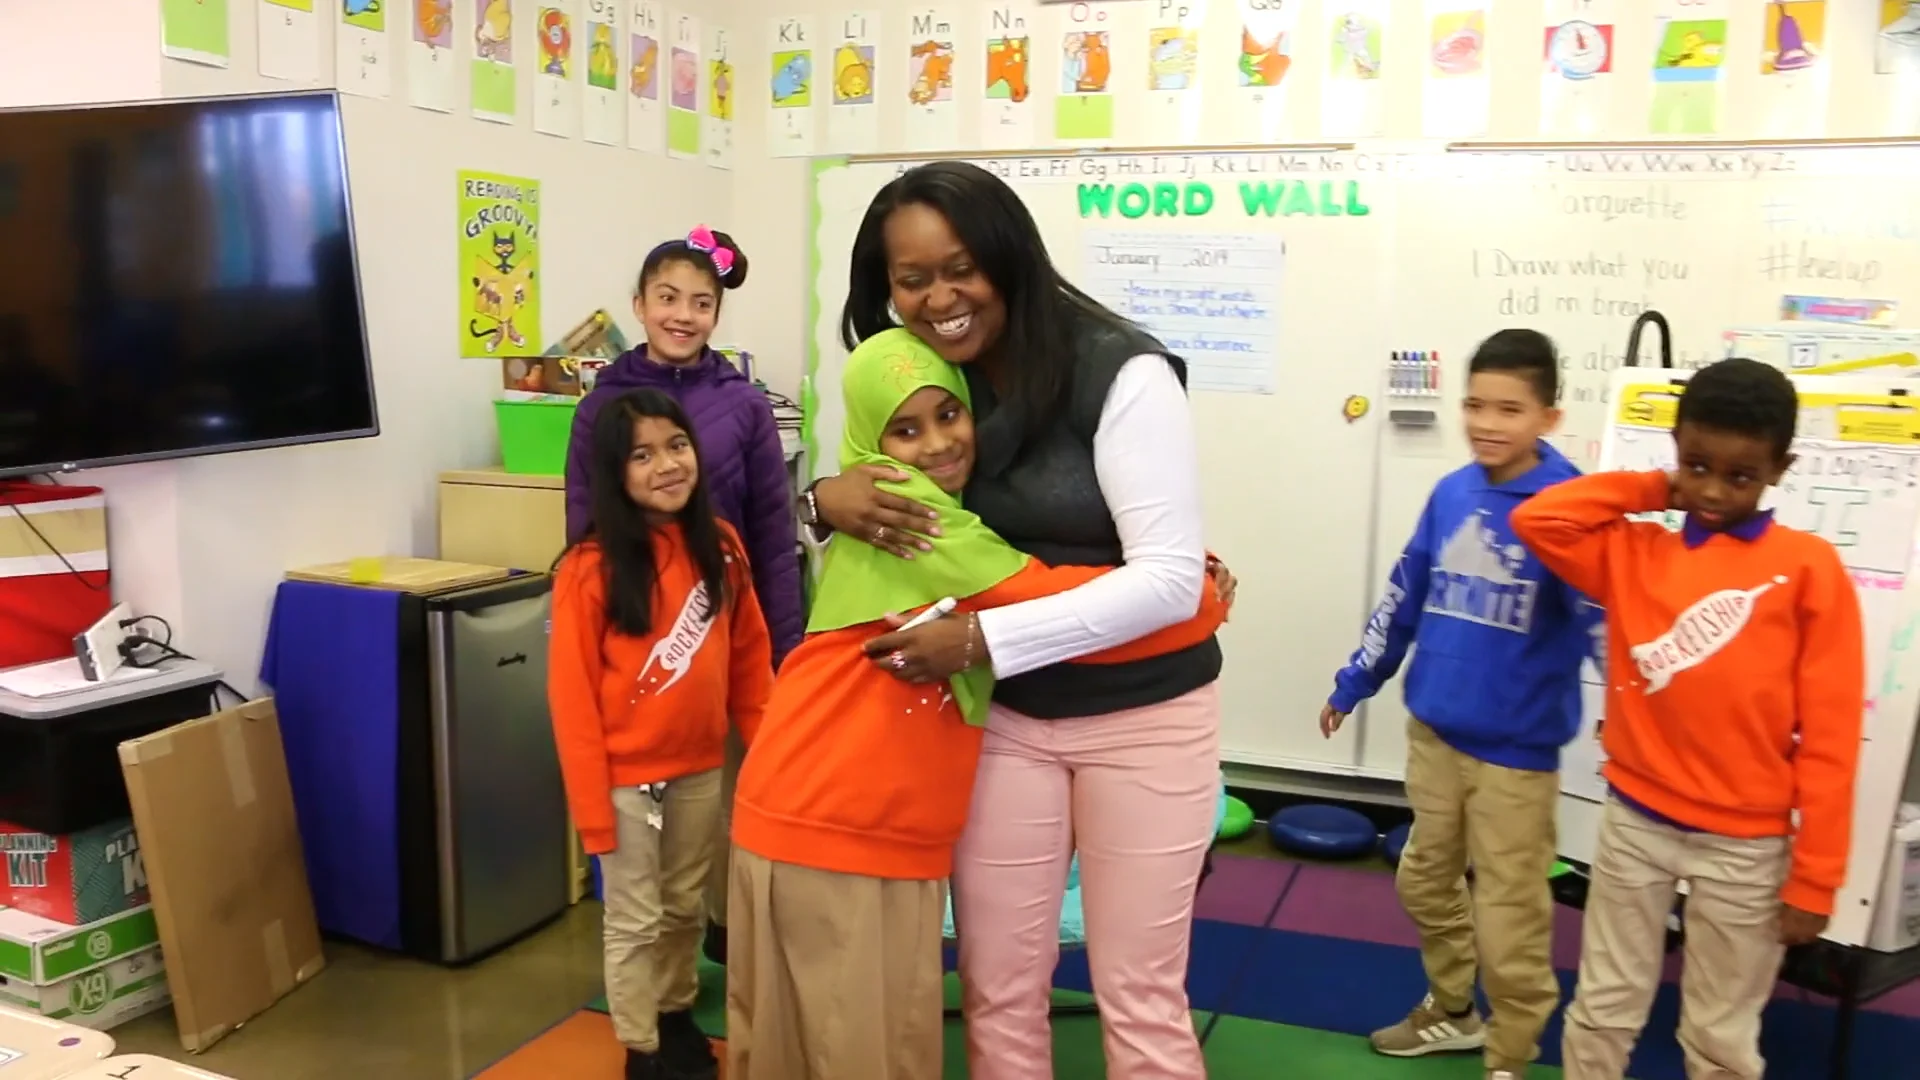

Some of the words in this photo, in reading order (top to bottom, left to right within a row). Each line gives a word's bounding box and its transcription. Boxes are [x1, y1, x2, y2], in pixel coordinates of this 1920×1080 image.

[912, 15, 950, 35] Mm
[993, 10, 1025, 29] Nn
[1071, 2, 1107, 22] Oo
[779, 23, 805, 43] Kk
[844, 19, 867, 39] Ll
[1019, 160, 1041, 176] Ee
[1050, 159, 1068, 176] Ff
[1080, 159, 1107, 181] Gg
[1117, 158, 1143, 174] Hh
[1180, 157, 1196, 179] Jj
[1212, 156, 1236, 173] Kk
[1247, 156, 1265, 172] Ll
[1602, 153, 1633, 172] Vv
[1642, 153, 1695, 172] Ww
[1706, 153, 1733, 172] Xx
[1739, 153, 1761, 178] Yy
[1077, 181, 1215, 219] WORD
[1238, 179, 1370, 217] WALL
[1550, 184, 1688, 221] arquette
[1095, 246, 1160, 273] January
[1491, 248, 1559, 278] Draw
[1567, 251, 1629, 279] what
[1641, 257, 1689, 287] you
[1498, 286, 1540, 315] did
[1642, 595, 1746, 674] ROCKETSHIP
[7, 852, 48, 887] KIT
[80, 972, 106, 1009] X9
